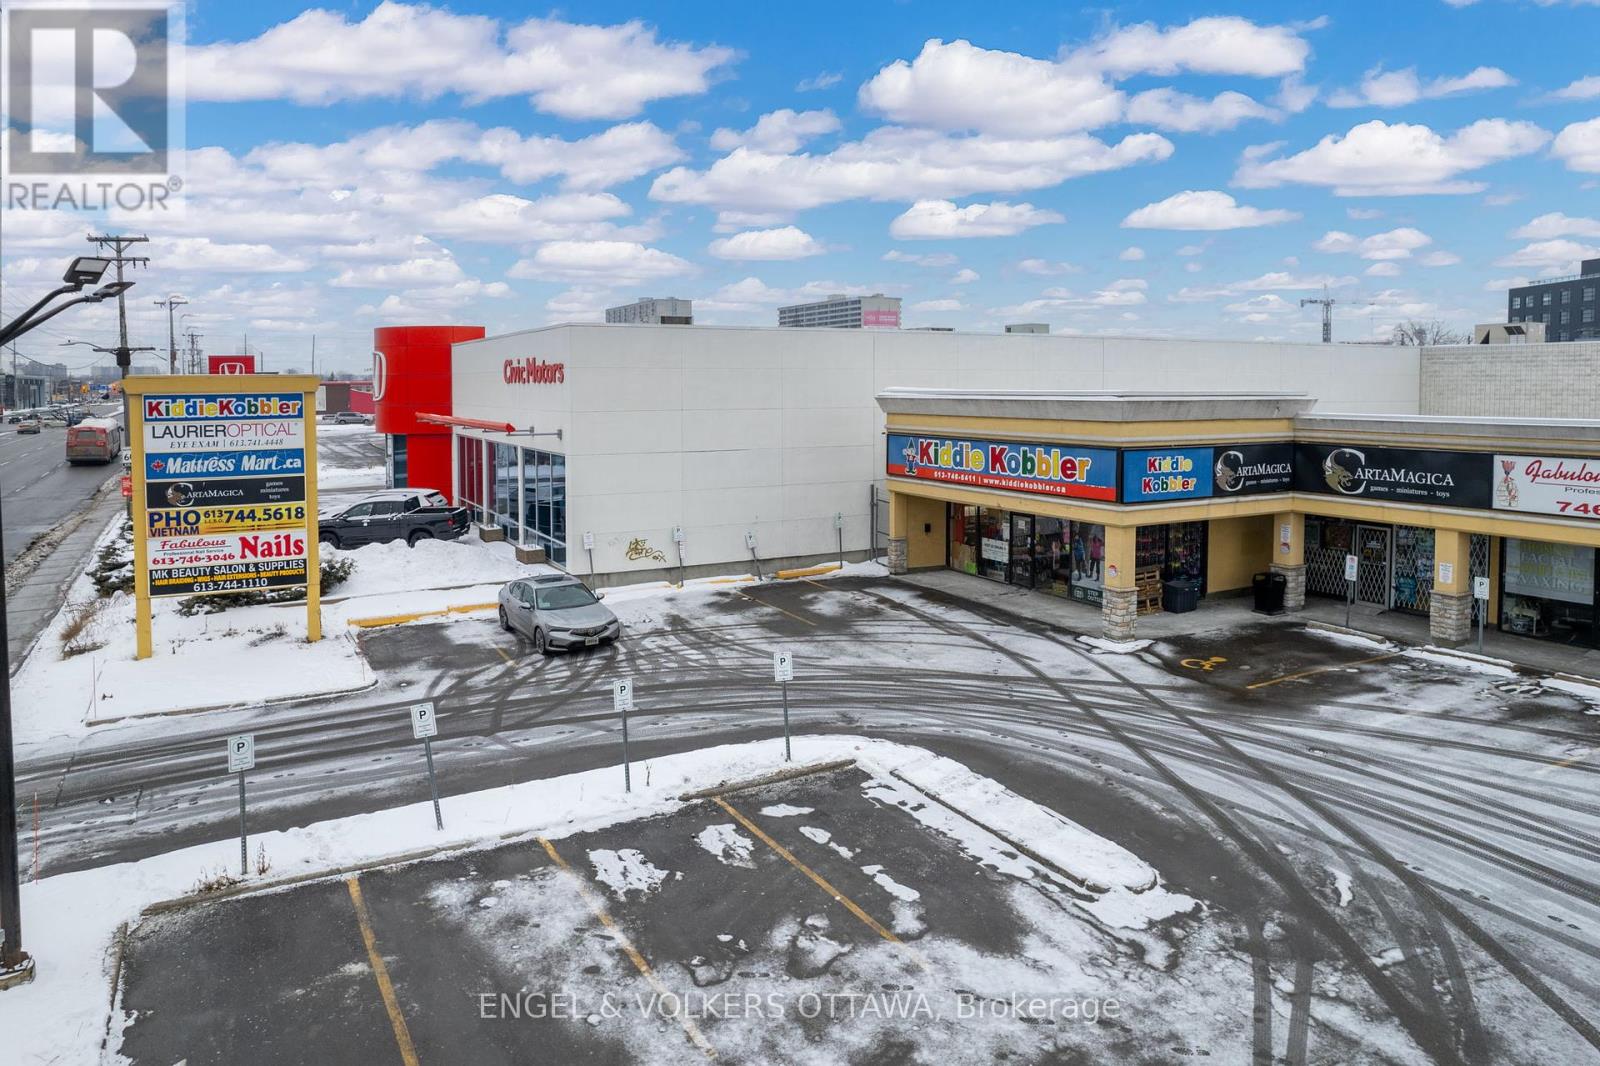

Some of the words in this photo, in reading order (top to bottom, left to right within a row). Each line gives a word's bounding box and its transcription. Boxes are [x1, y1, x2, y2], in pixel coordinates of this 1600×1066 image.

[503, 358, 526, 384] Civic
[526, 357, 565, 384] Motors
[191, 440, 219, 448] EXAM
[165, 455, 236, 474] Mattress
[918, 438, 985, 470] Kiddie
[989, 444, 1091, 482] Kobbler
[1147, 456, 1193, 473] Kiddie
[1142, 476, 1197, 494] Kobbler
[1396, 487, 1428, 496] miniatures
[1436, 490, 1450, 499] toys
[149, 510, 201, 528] PHO
[204, 509, 224, 518] 613
[224, 506, 305, 524] 744.5618
[150, 526, 200, 537] VIETNAM
[160, 538, 226, 549] Fabulous
[239, 534, 304, 560] Nails
[152, 552, 235, 565] 613-746-3046
[152, 570, 169, 579] MK
[171, 566, 211, 578] BEAUTY
[213, 564, 246, 575] SALON
[249, 563, 256, 572] &
[258, 559, 305, 572] SUPPLIES
[193, 577, 268, 592] 613-744-1110
[779, 657, 787, 666] P
[619, 685, 627, 695] P
[418, 709, 427, 720] P
[236, 742, 245, 752] P
